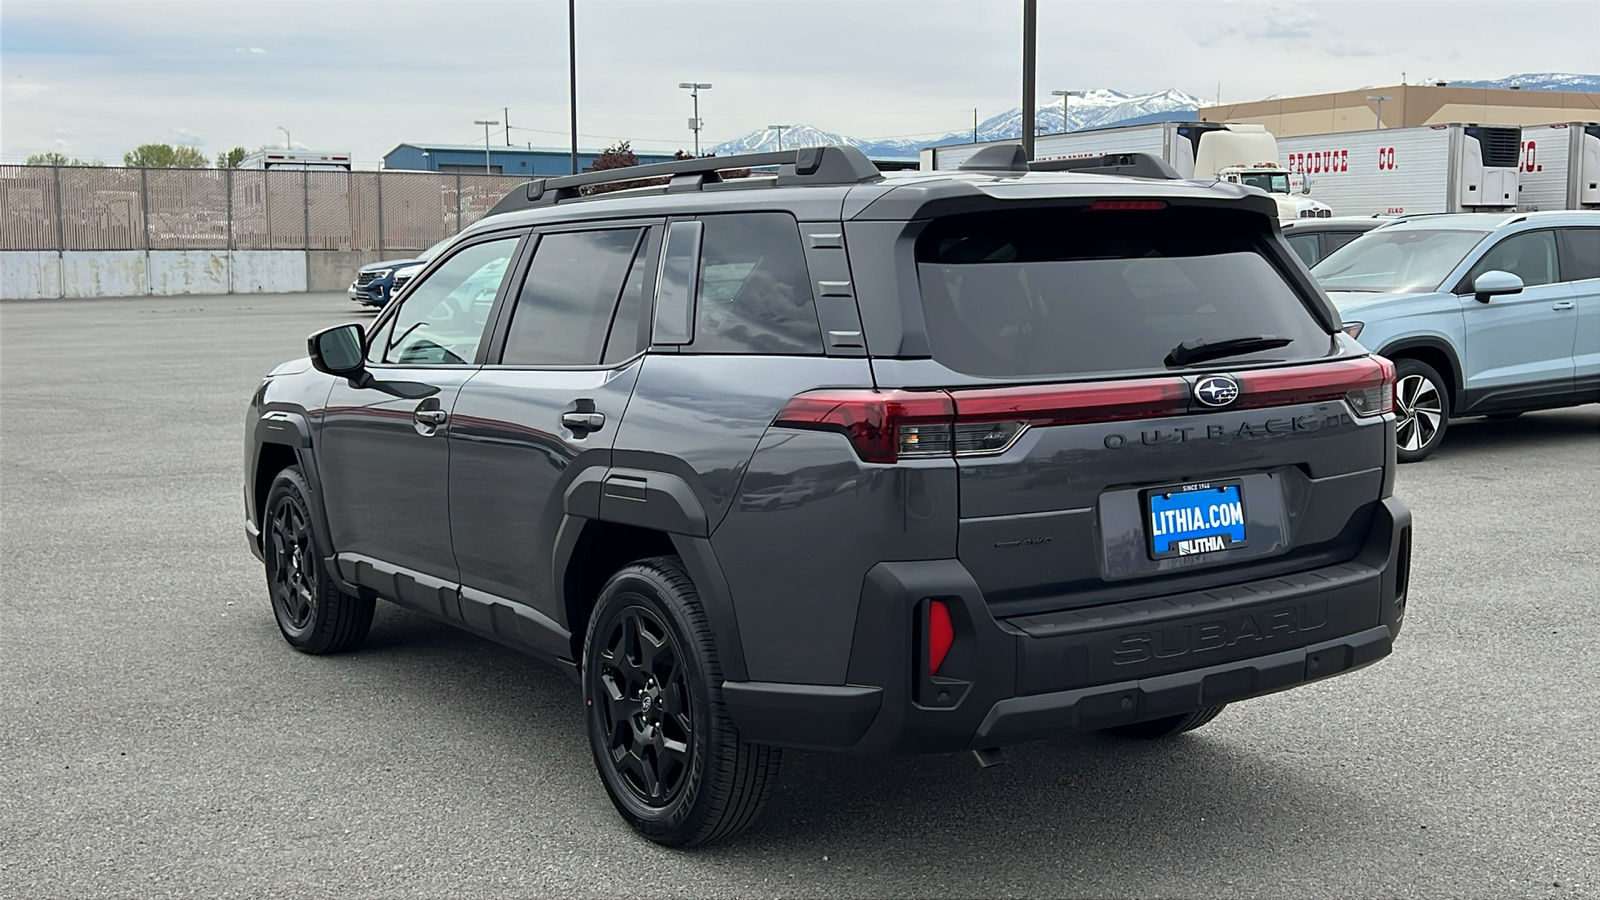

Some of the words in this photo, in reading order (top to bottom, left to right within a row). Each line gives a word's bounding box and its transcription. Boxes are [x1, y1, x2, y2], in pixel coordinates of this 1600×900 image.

[1288, 150, 1348, 174] PRODUCE
[1378, 147, 1398, 170] CO.
[1103, 415, 1308, 450] OUTBACK
[1182, 484, 1198, 492] SINCE
[1151, 502, 1244, 537] LITHIA.COM
[1189, 536, 1226, 554] LITHIA
[1112, 599, 1329, 666] SUBARU
